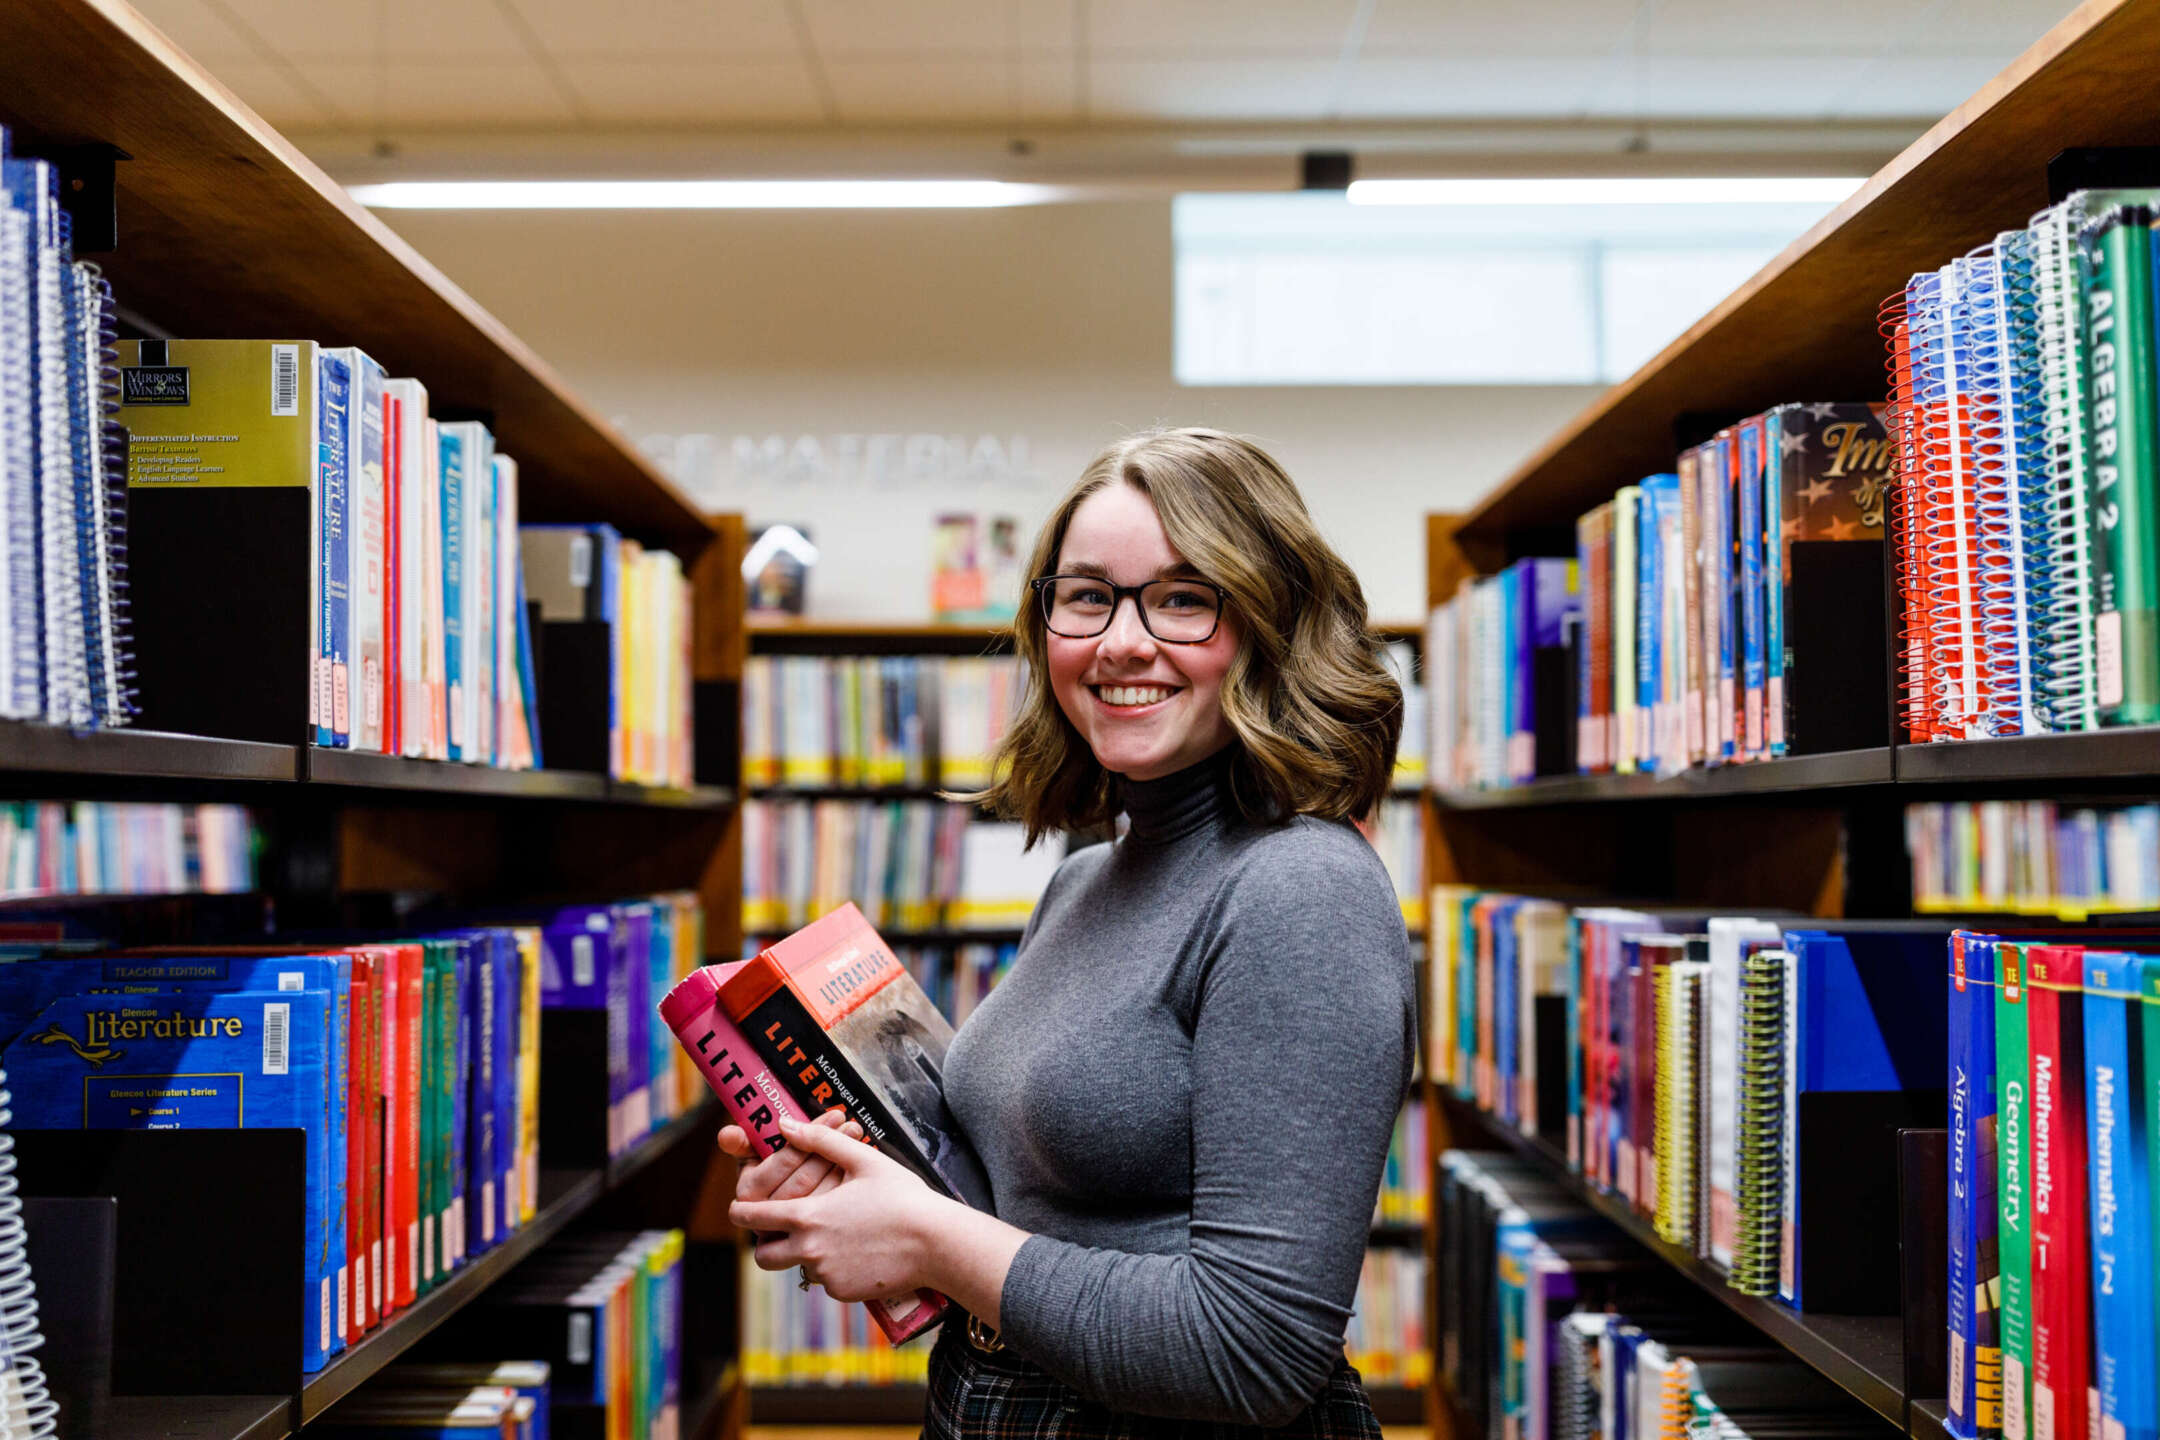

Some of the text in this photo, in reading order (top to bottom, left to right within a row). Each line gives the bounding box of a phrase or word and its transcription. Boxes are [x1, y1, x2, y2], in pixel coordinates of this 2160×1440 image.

[127, 370, 182, 383] MIRRORS
[127, 382, 185, 395] WINDOWS
[2088, 290, 2118, 493] ALGEBRA
[129, 434, 239, 442] DIFFERENTIATED INSTRUCTION
[1822, 422, 1894, 480] Im
[1903, 410, 1916, 473] Math
[138, 456, 174, 465] Developing
[138, 466, 162, 474] English
[163, 466, 194, 474] Language
[326, 399, 345, 540] LITERATURE
[731, 433, 1046, 492] MATERIAL
[2095, 501, 2119, 532] 2
[1906, 477, 1920, 593] Connects
[115, 966, 216, 978] TEACHER EDITION
[819, 949, 892, 1005] LITERATURE
[2006, 967, 2018, 983] TE
[2033, 963, 2048, 979] TE
[2092, 969, 2108, 987] TE
[124, 985, 159, 994] Glencoe
[86, 1011, 243, 1047] Literature
[121, 1008, 158, 1017] Glencoe
[146, 1088, 188, 1097] Literature
[190, 1087, 217, 1096] Series
[765, 1021, 878, 1150] LITER
[816, 1054, 886, 1140] McDougal Littell
[1952, 1065, 1967, 1200] Algebra 2
[2035, 1056, 2052, 1214] Mathematics
[2004, 1080, 2024, 1233] Geometry
[2096, 1066, 2118, 1236] Mathematics
